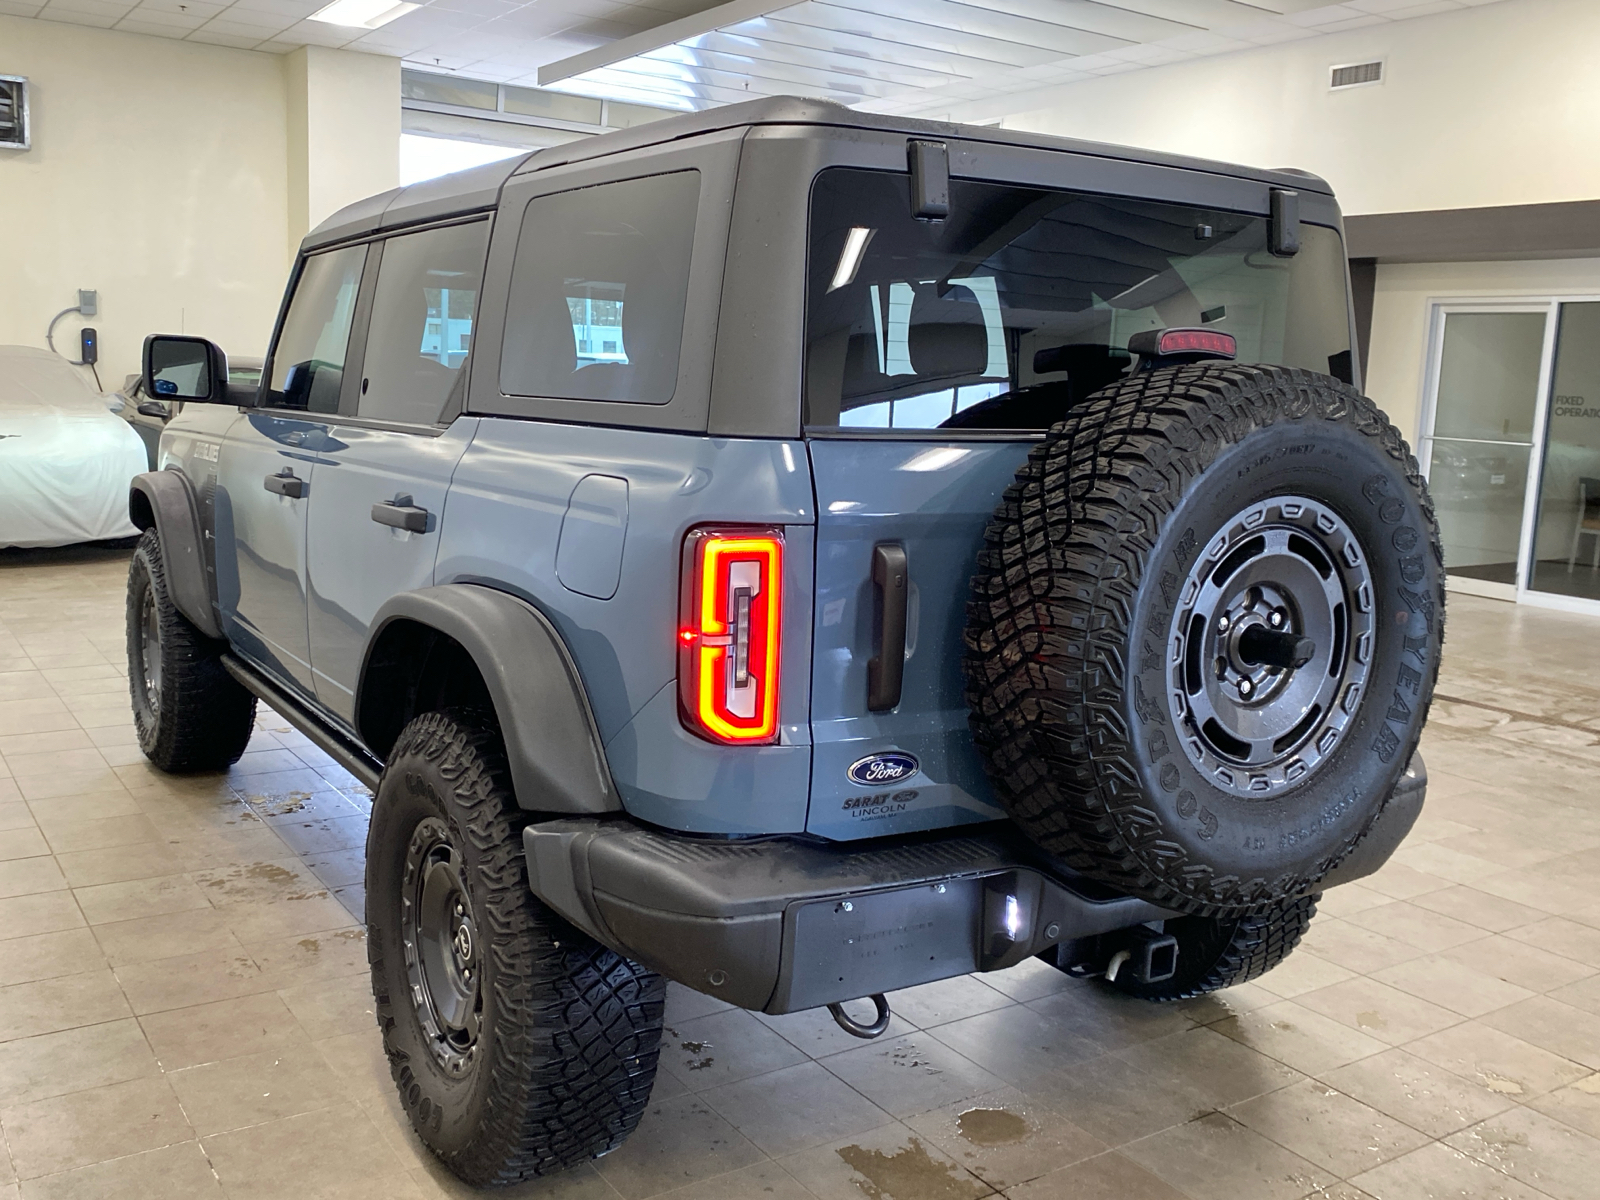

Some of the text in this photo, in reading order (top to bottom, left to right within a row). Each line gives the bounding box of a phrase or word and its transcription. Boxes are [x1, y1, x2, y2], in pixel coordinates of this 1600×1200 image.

[1555, 395, 1585, 406] FIXED
[866, 761, 904, 780] Ford
[842, 793, 891, 810] SARAT
[852, 804, 906, 818] LINCOLN
